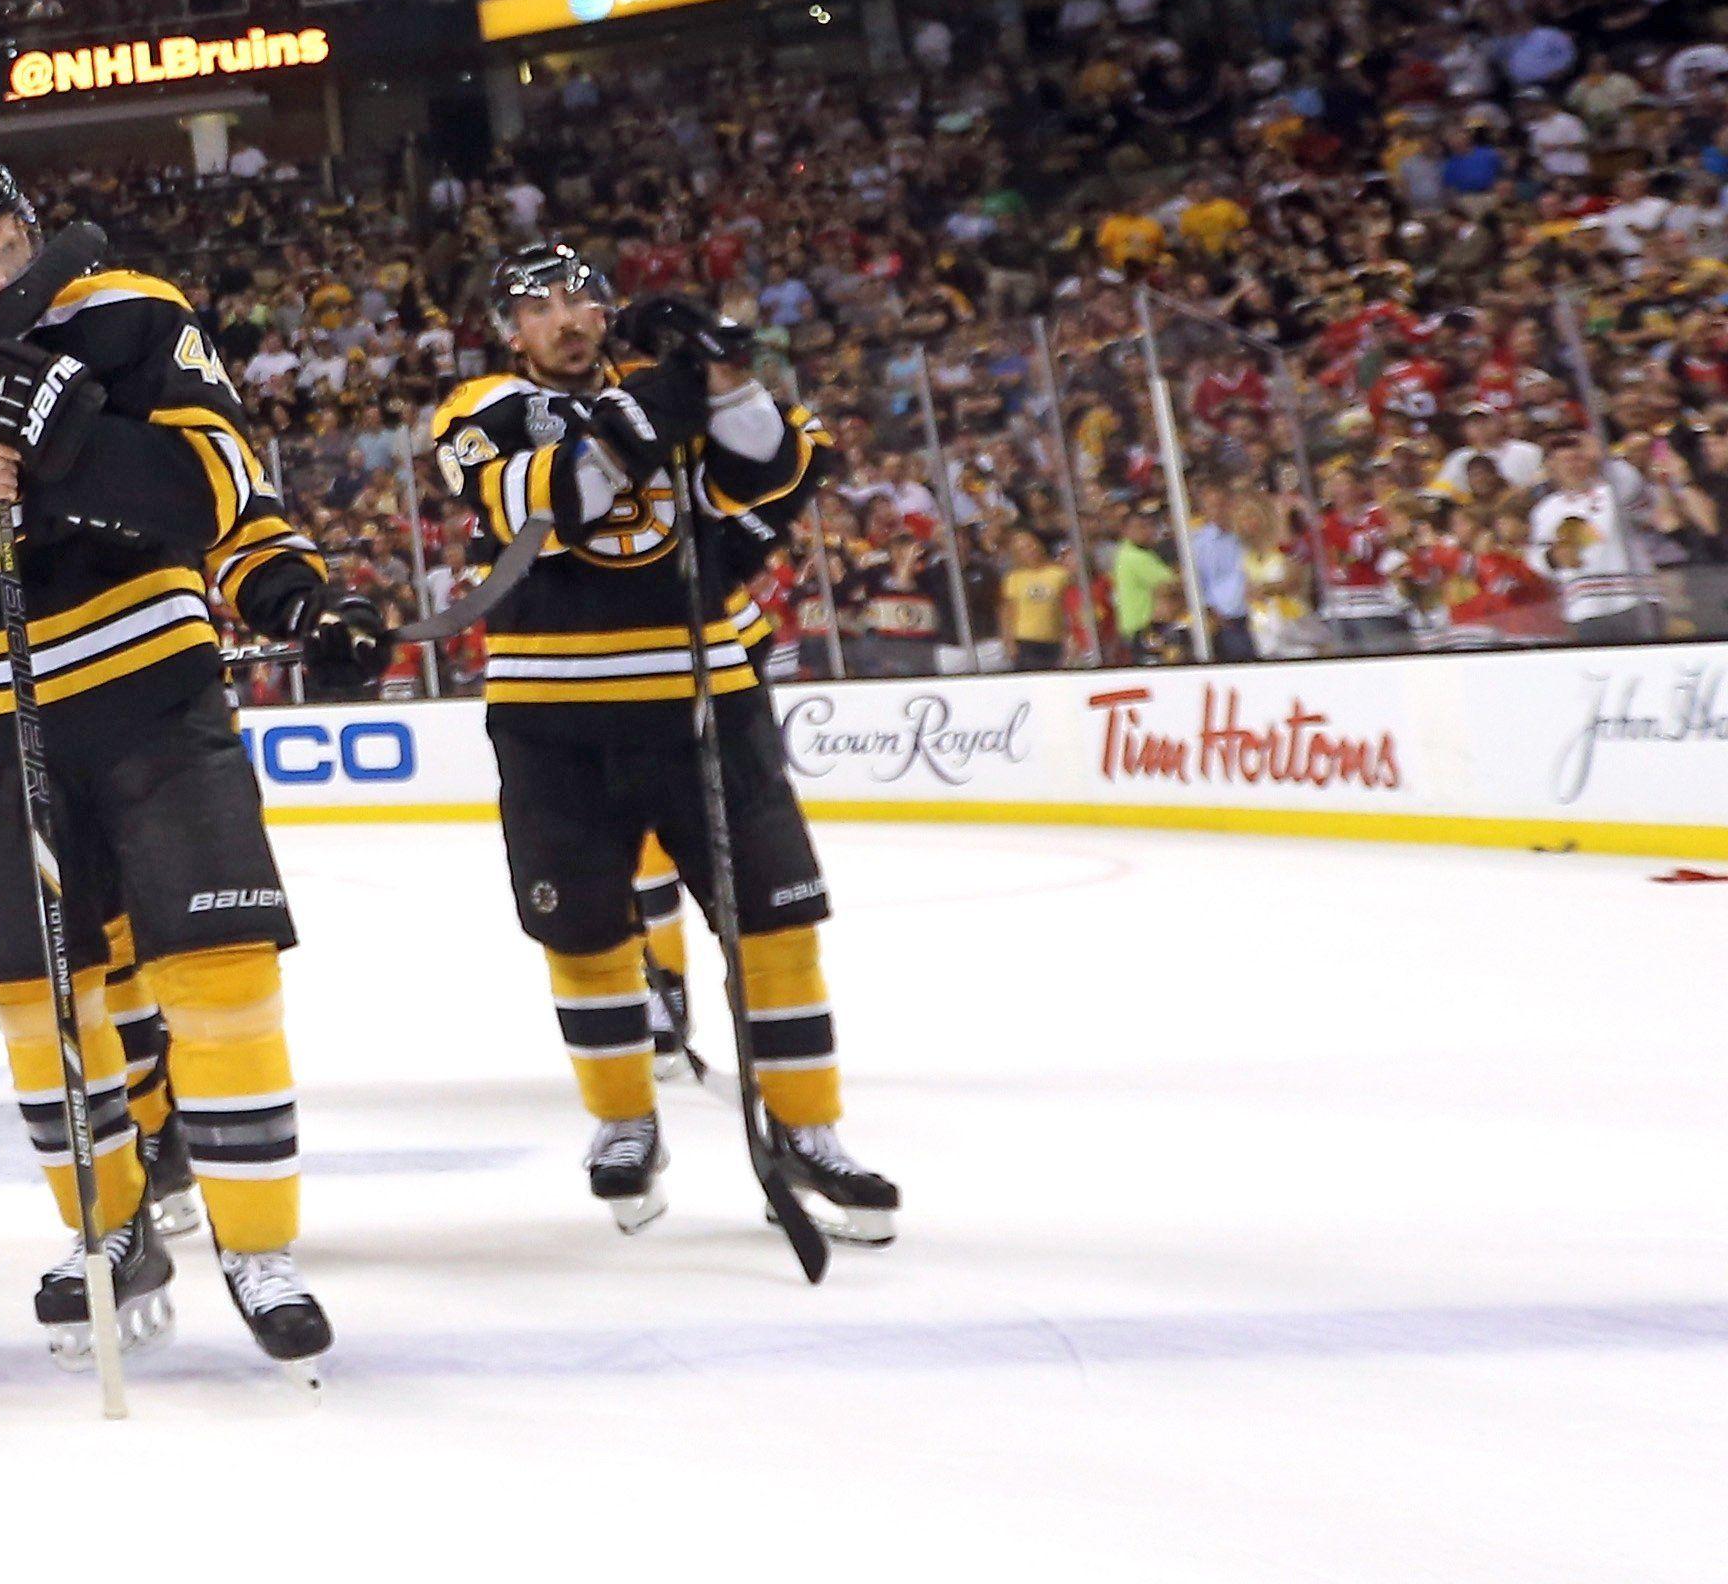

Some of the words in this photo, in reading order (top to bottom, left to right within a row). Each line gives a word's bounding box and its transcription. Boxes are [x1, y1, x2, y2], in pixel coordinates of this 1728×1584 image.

[6, 25, 330, 104] @NHLBruins
[783, 695, 904, 778] Crown
[867, 694, 1033, 785] Royal
[1089, 686, 1189, 784] Tim
[1201, 681, 1403, 789] Hortons
[71, 1089, 92, 1168] BAUER
